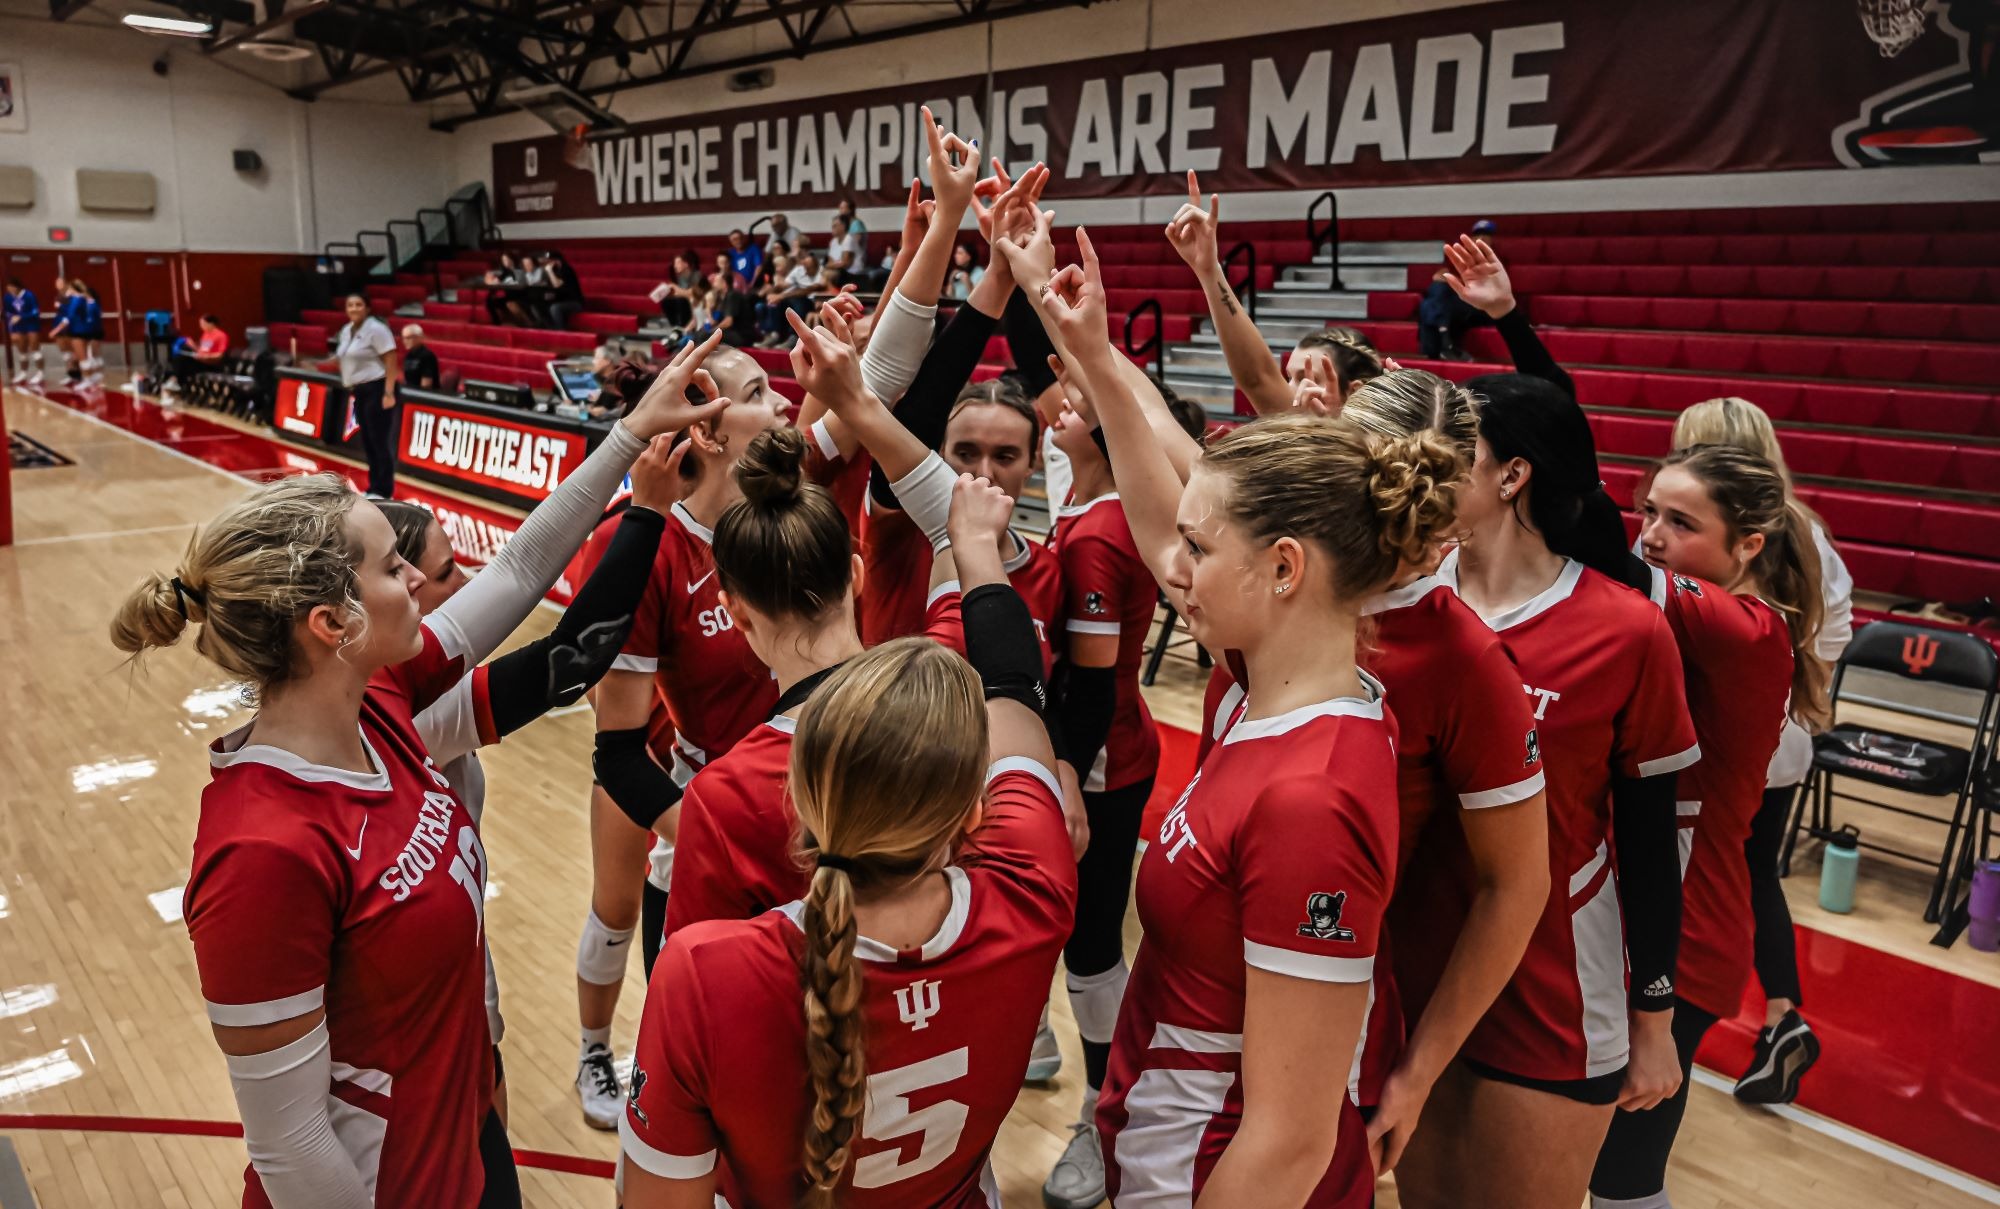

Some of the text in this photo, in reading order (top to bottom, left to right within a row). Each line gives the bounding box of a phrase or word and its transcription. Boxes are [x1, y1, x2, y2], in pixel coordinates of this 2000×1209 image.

[592, 126, 722, 206] WHERE
[1065, 64, 1225, 179] ARE
[1247, 22, 1565, 169] MADE
[433, 416, 567, 492] SOUTHEAST
[852, 1046, 970, 1189] 5
